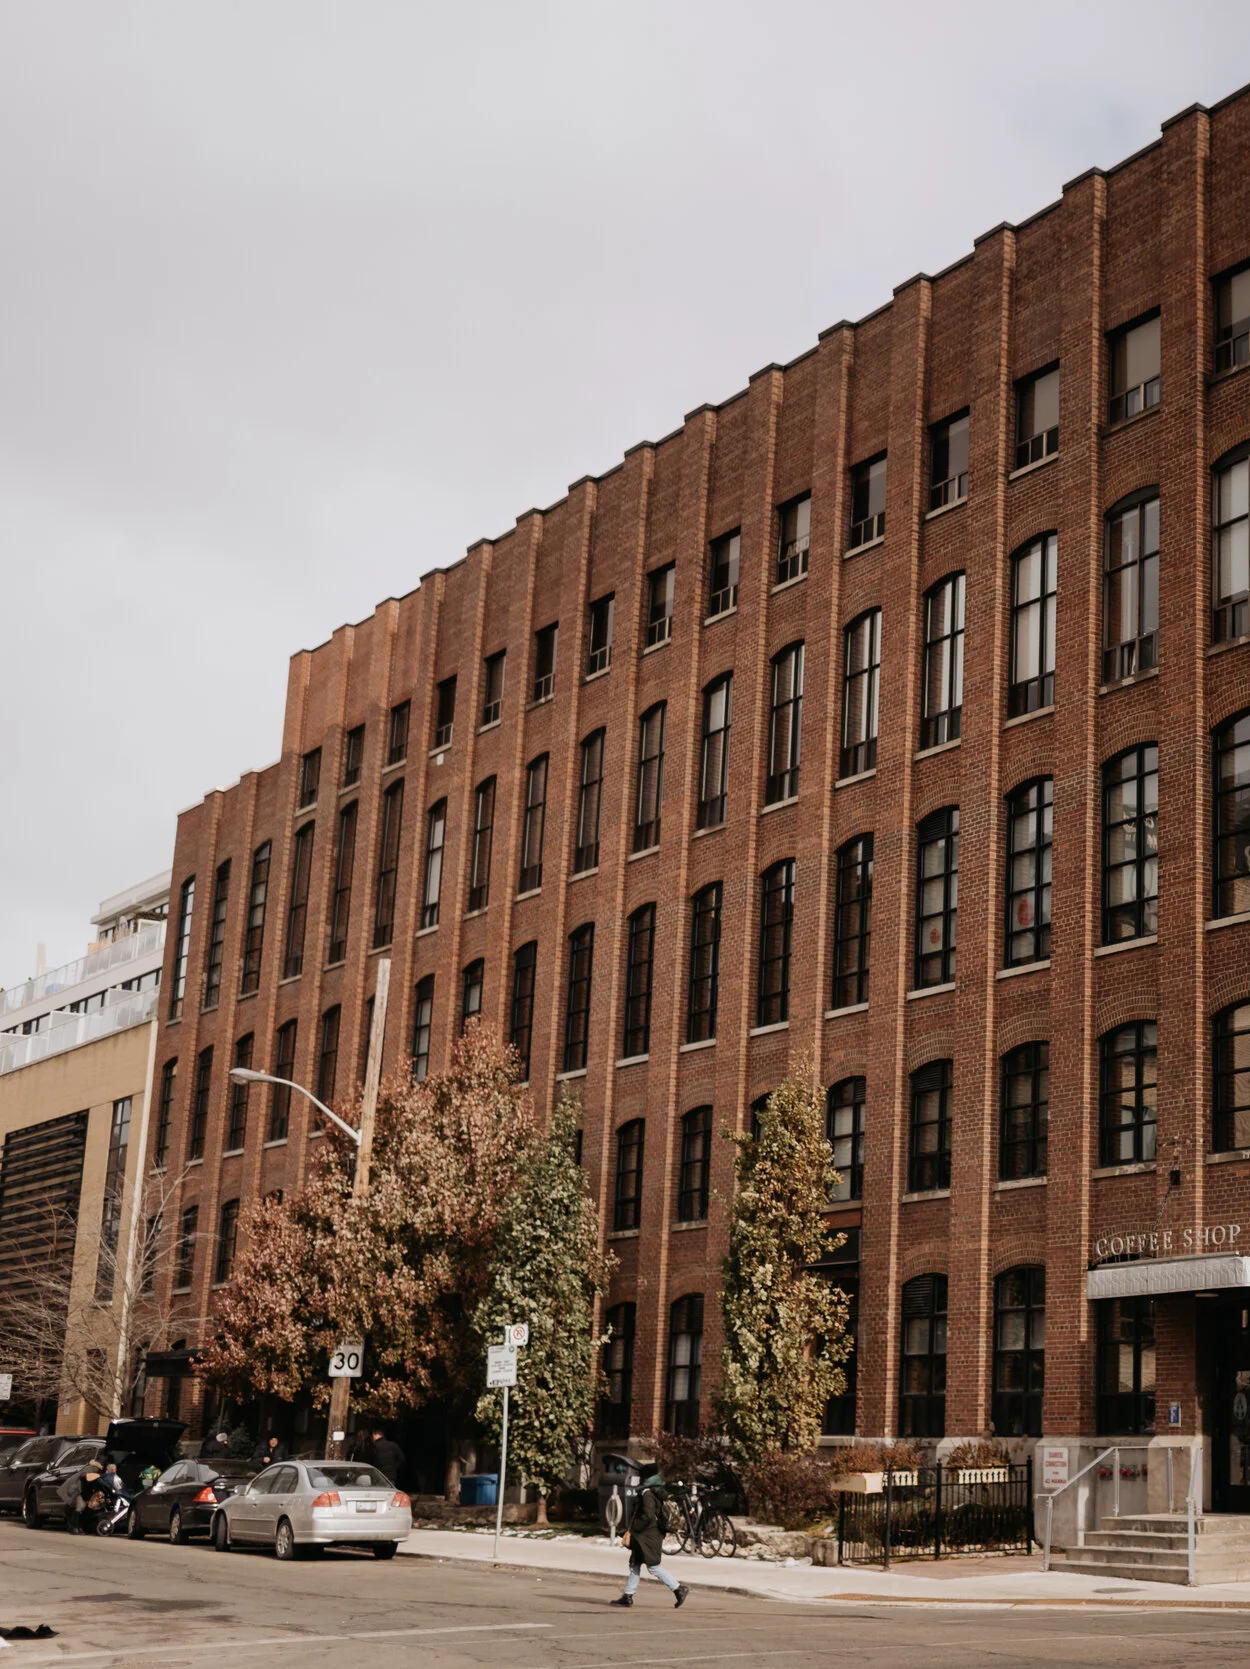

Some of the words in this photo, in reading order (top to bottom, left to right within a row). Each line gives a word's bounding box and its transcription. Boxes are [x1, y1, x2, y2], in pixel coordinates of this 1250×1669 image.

[1096, 1231, 1173, 1257] COFFEE
[1183, 1224, 1241, 1248] SHOP
[334, 1352, 359, 1370] 30
